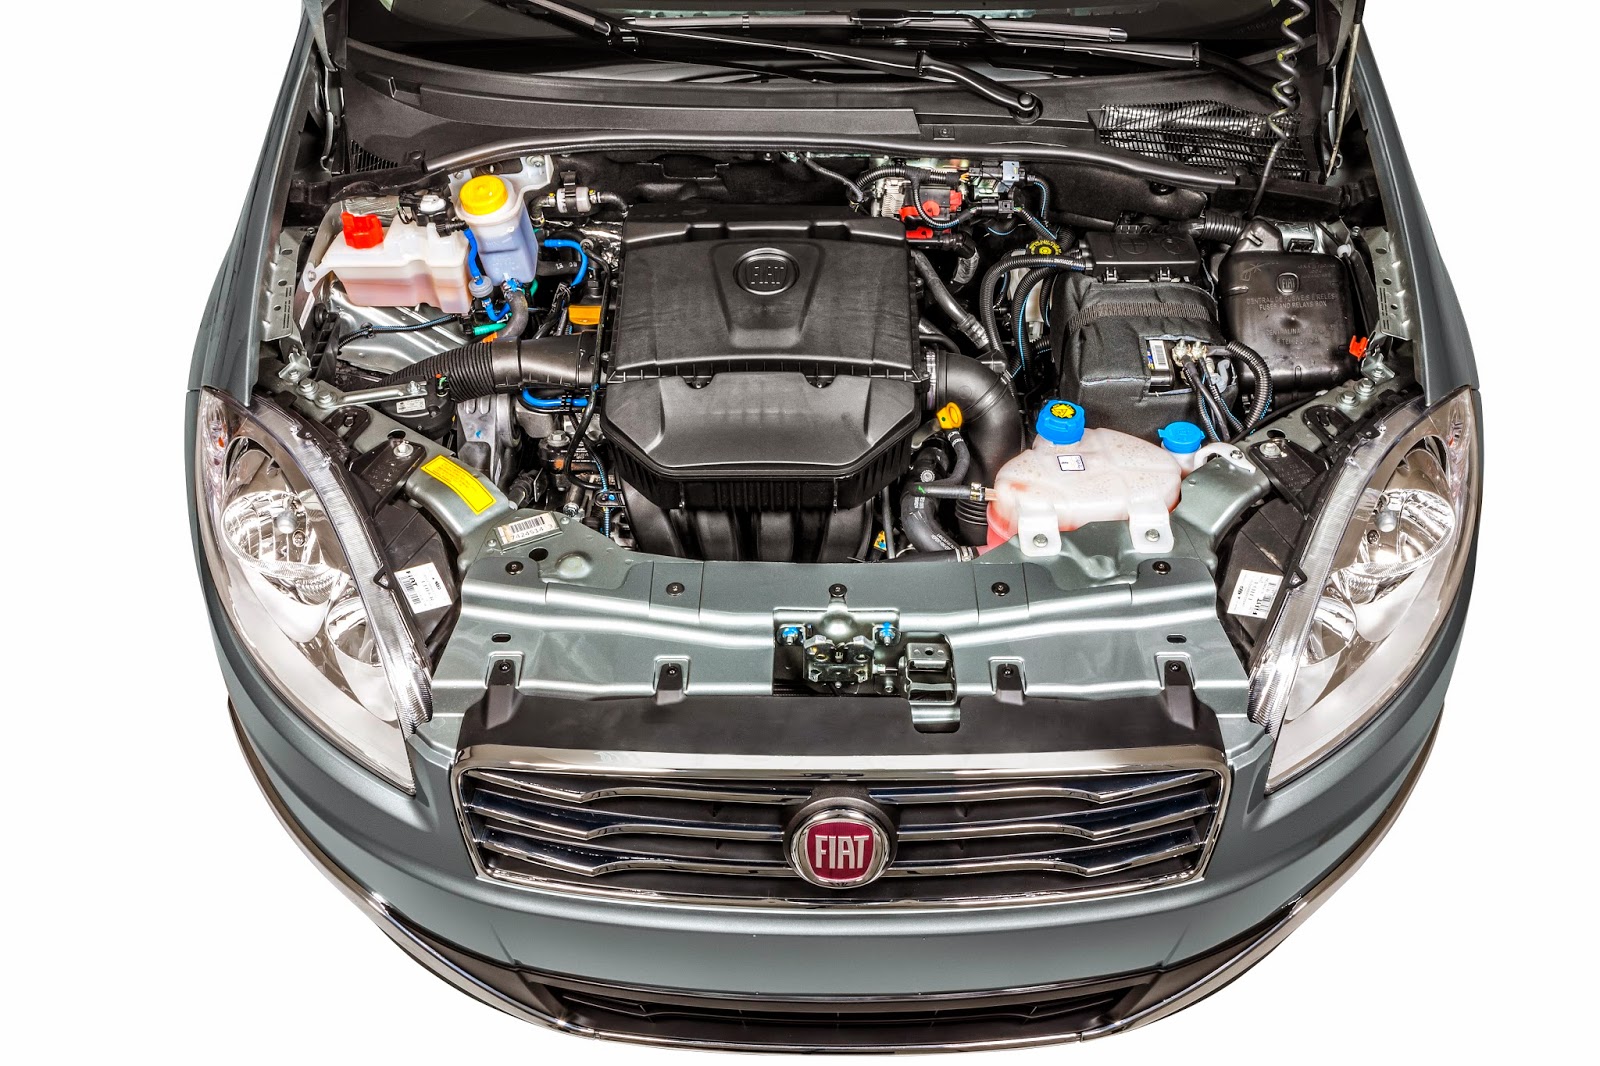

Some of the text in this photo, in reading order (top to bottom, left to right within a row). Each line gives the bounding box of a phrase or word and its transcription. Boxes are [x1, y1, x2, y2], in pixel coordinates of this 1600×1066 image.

[750, 266, 785, 285] FIAT
[1282, 278, 1296, 289] FIAT
[1259, 303, 1278, 311] FUSES
[1292, 301, 1313, 309] RELAYS
[815, 834, 869, 869] FIAT
